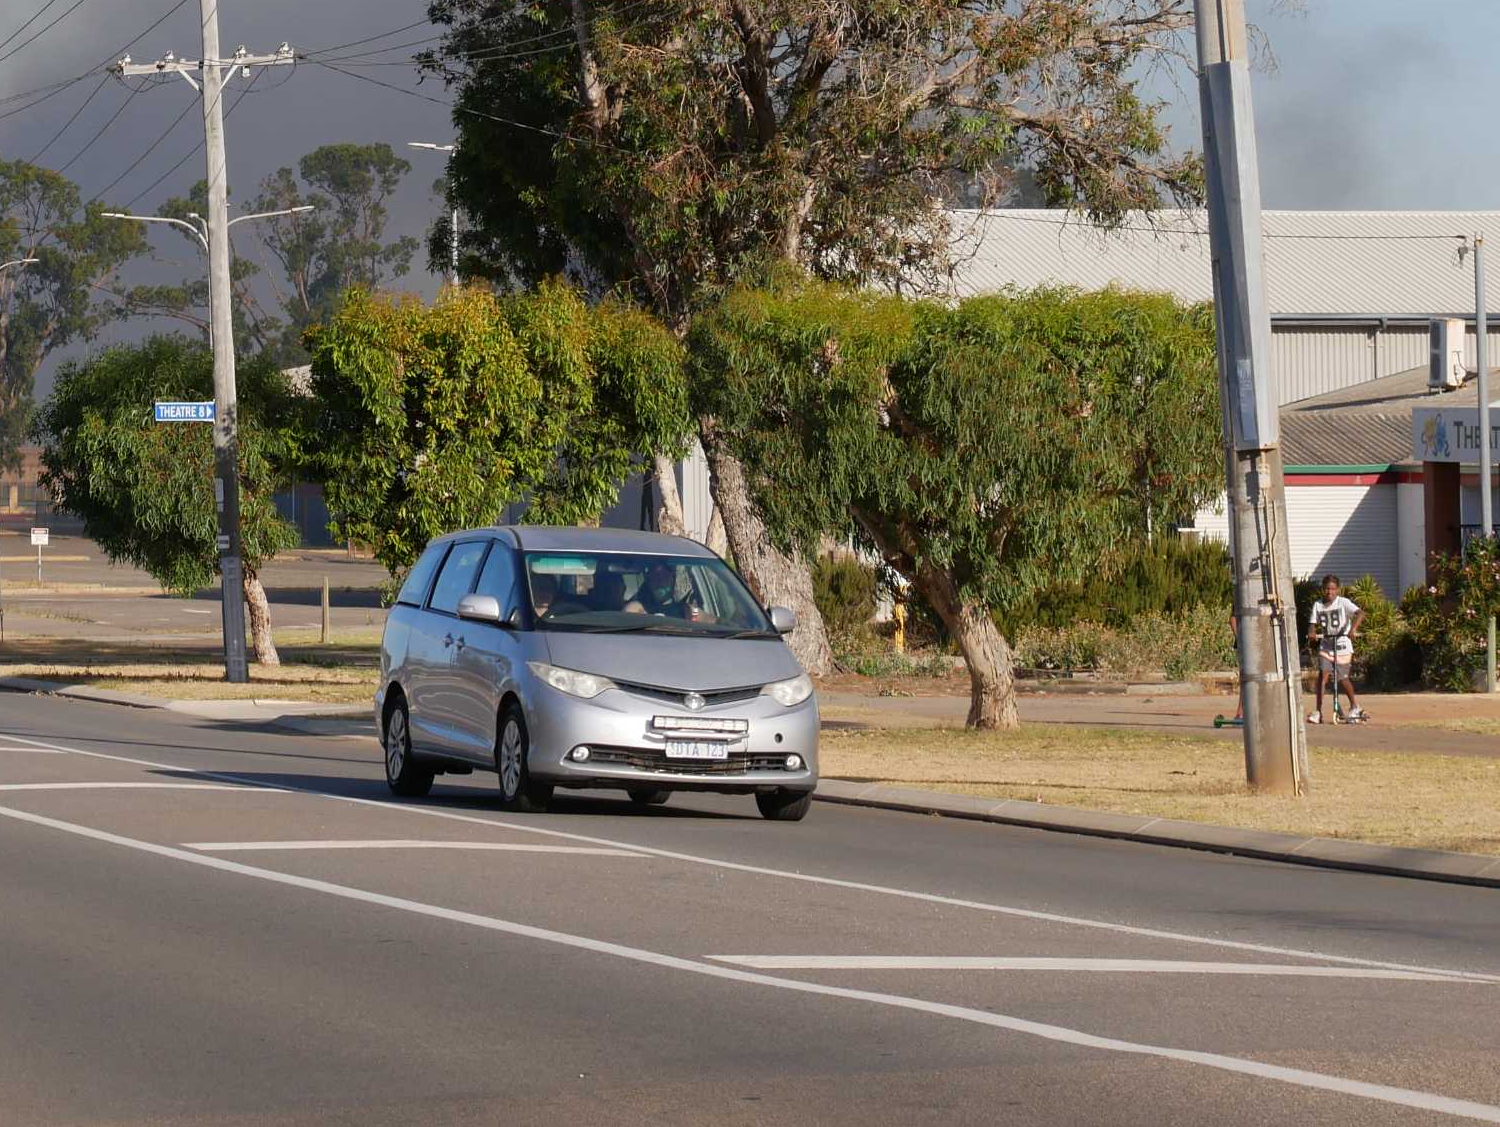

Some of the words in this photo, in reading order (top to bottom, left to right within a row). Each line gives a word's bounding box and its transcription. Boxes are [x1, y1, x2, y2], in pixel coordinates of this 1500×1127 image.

[159, 406, 197, 418] THEATRE
[199, 406, 205, 418] 8
[1453, 420, 1500, 449] THET
